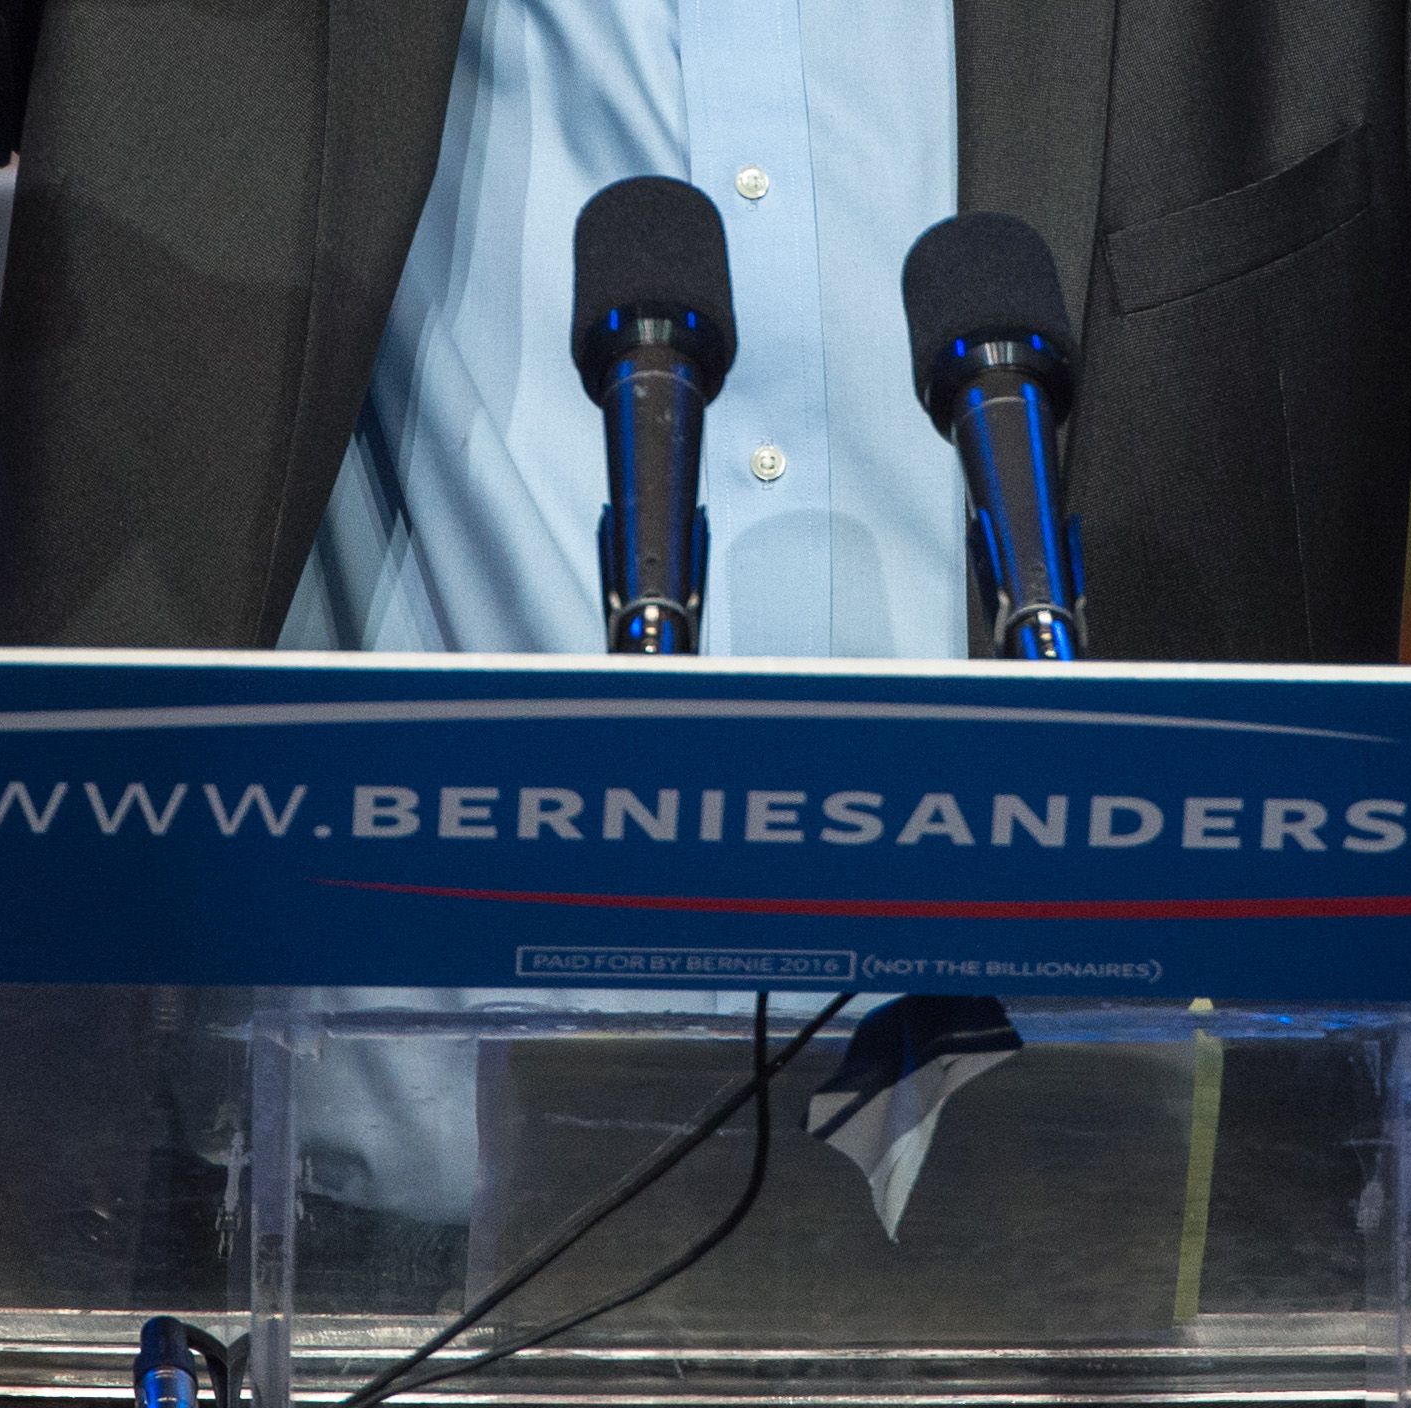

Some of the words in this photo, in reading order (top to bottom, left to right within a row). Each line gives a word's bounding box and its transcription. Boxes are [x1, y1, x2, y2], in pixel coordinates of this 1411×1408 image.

[532, 953, 588, 970] PAID
[593, 954, 645, 971] FOR
[650, 956, 682, 973] BY
[686, 955, 774, 973] BERNIE
[779, 957, 841, 974] 2016
[861, 954, 928, 979] (NOT
[932, 958, 981, 976] THE
[985, 958, 1163, 984] BILLIONAIRES)
